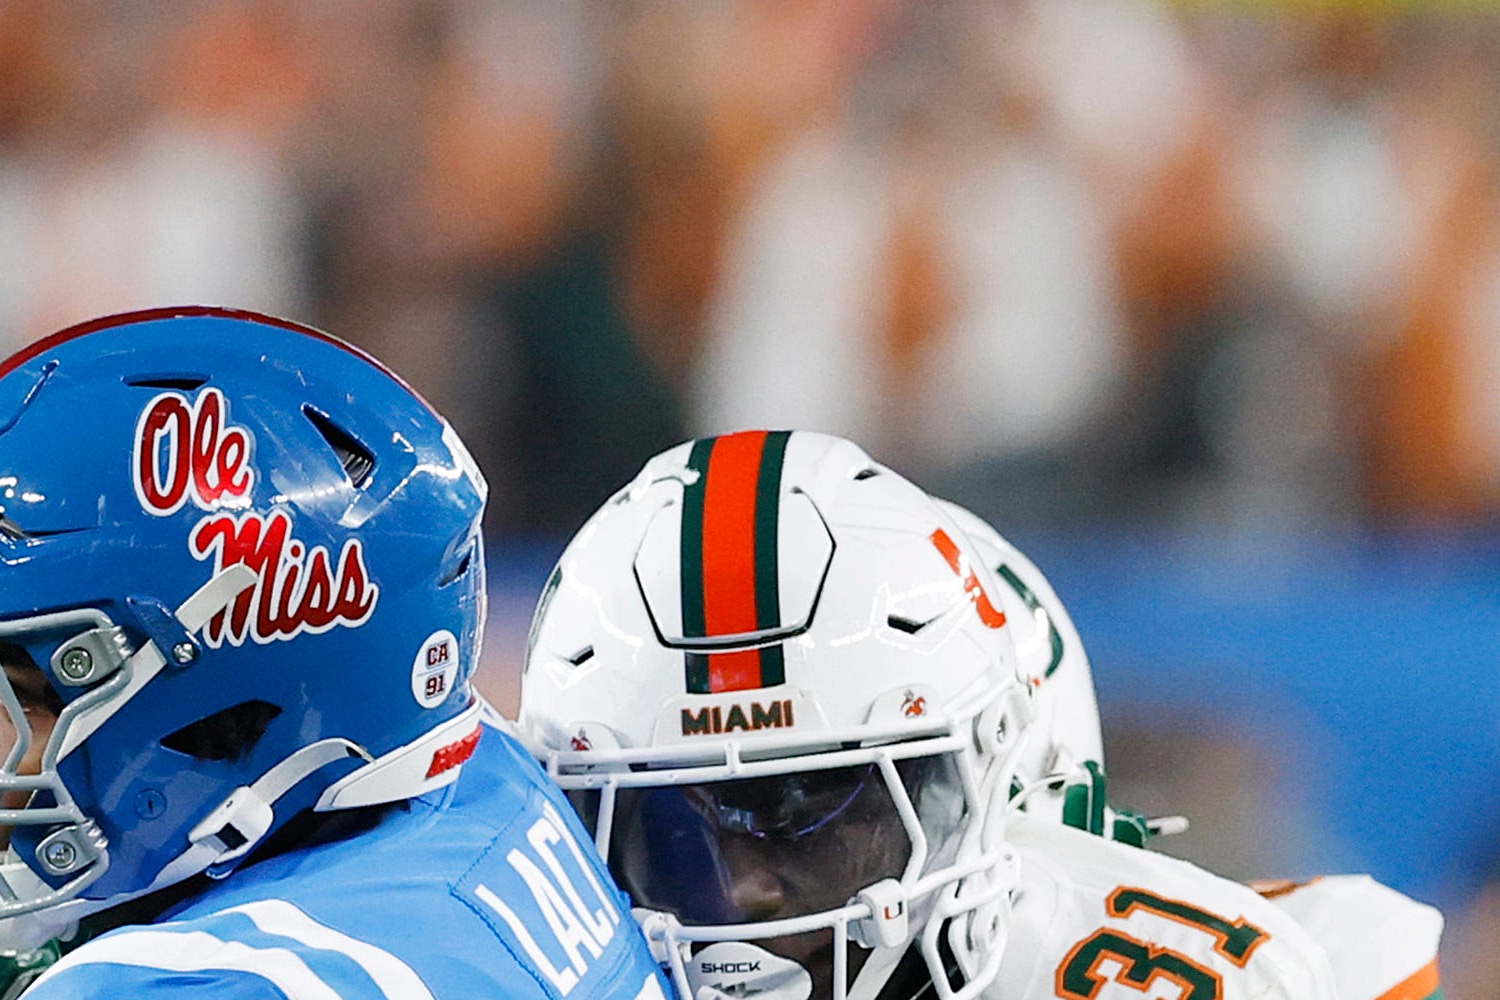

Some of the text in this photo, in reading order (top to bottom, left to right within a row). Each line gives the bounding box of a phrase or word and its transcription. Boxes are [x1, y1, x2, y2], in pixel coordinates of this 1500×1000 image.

[134, 389, 253, 515] Ole
[189, 508, 378, 647] Miss
[426, 641, 449, 667] CA
[425, 673, 446, 697] 91
[681, 699, 794, 736] MIAMI
[884, 901, 903, 920] U
[701, 960, 762, 974] SHOCK
